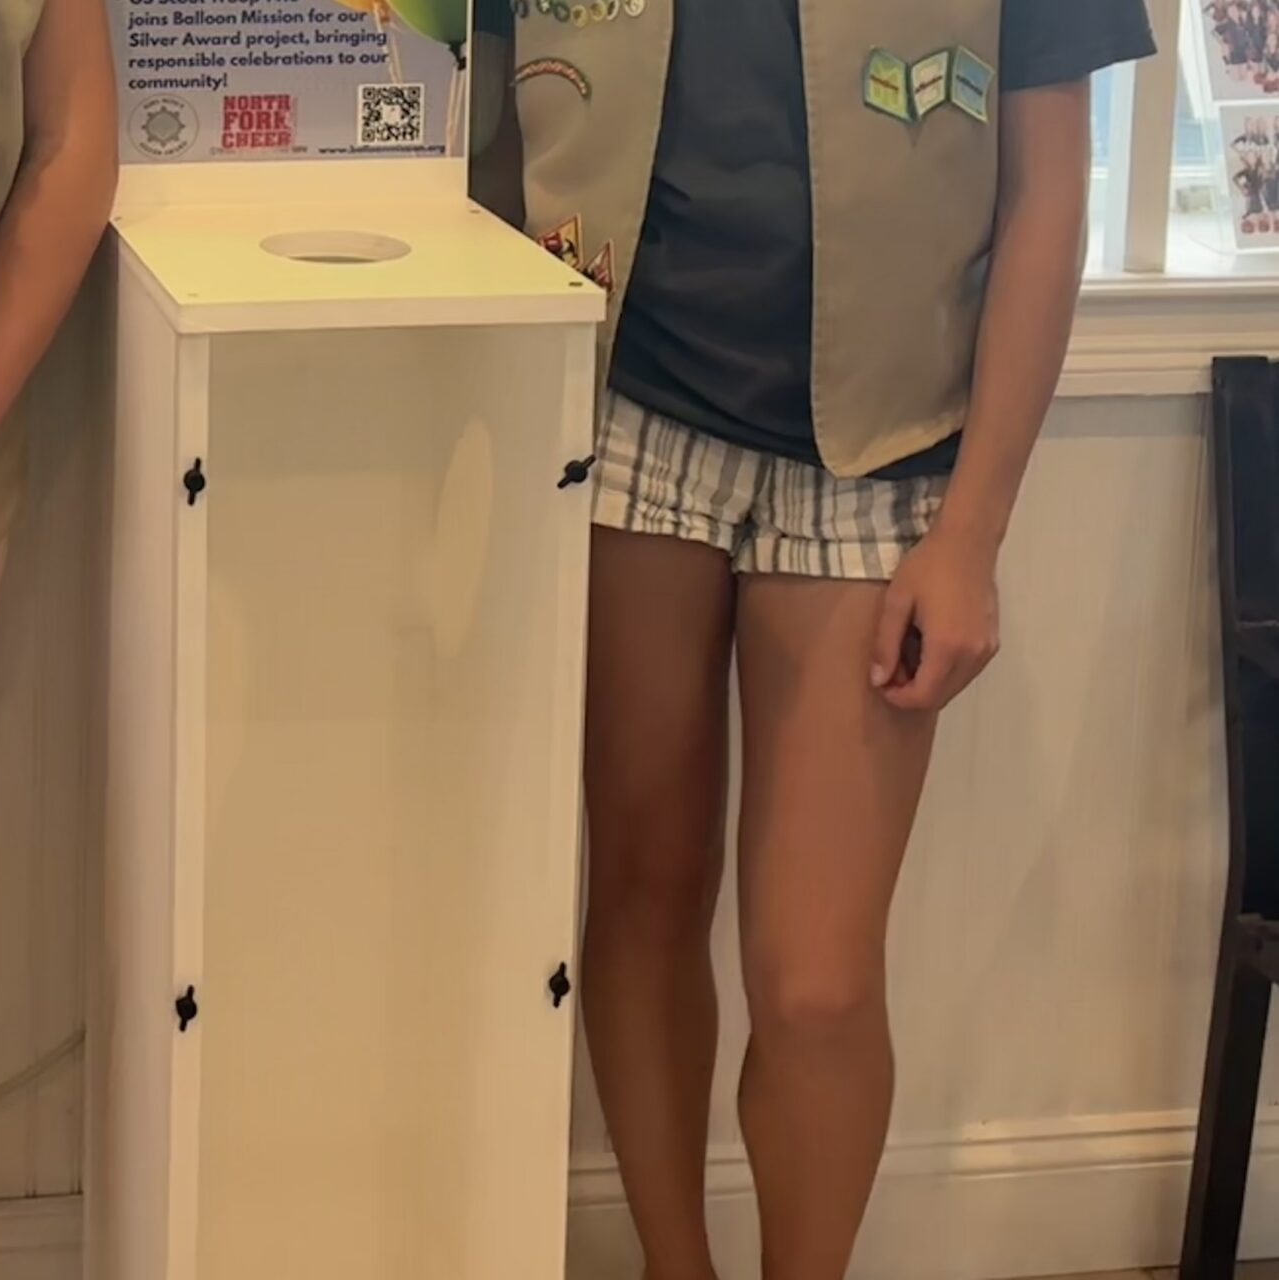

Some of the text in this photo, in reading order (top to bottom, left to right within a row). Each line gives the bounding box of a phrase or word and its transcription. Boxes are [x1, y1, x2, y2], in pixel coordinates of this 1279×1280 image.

[128, 8, 368, 30] joins Balloon Mission for our
[128, 29, 388, 49] Silver Award project, bringing
[128, 51, 390, 70] responsible celebrations to our
[128, 73, 228, 91] community!
[223, 94, 291, 110] NORTH
[223, 111, 291, 131] FORK
[222, 131, 291, 149] CHEER
